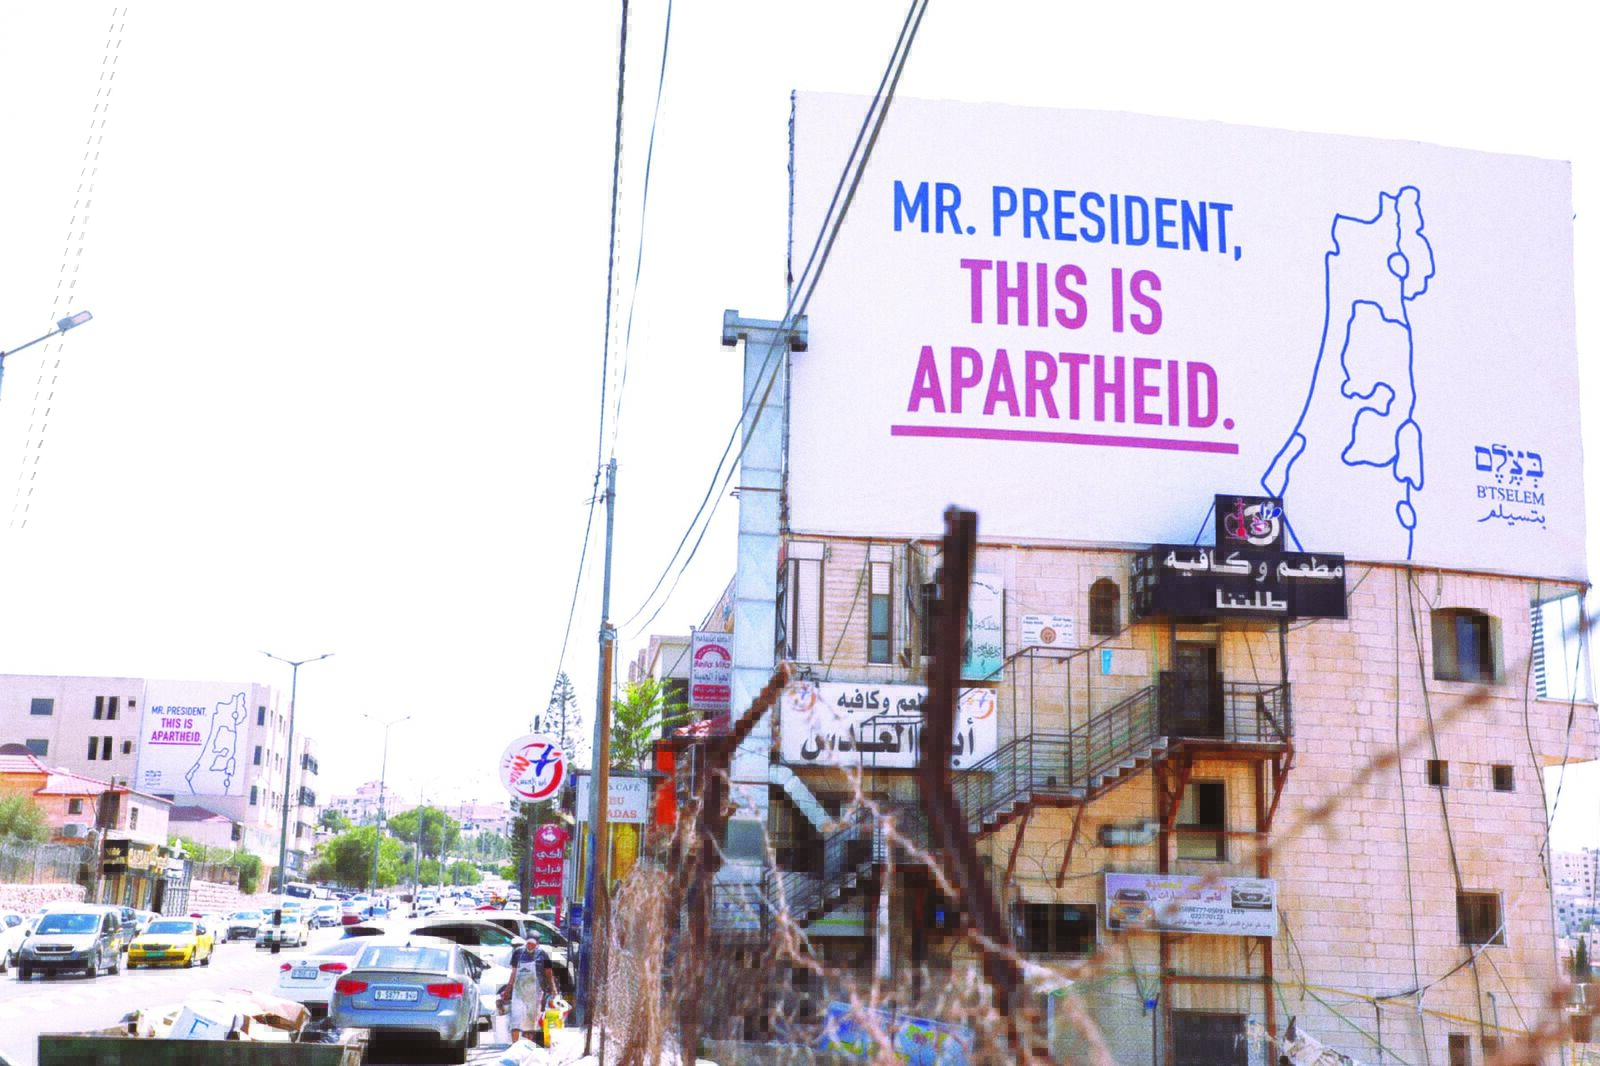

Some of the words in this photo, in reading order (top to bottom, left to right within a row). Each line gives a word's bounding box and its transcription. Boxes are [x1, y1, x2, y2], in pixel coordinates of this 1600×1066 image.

[893, 179, 977, 236] MR.
[992, 185, 1243, 262] PRESIDENT,
[960, 258, 1088, 331] THIS
[1111, 267, 1163, 336] IS
[907, 345, 1236, 430] APARTHEID.
[1276, 556, 1344, 582] مطعم
[896, 692, 927, 716] طعم
[151, 731, 202, 742] APARTHEID.
[161, 718, 181, 729] THIS
[184, 718, 194, 729] IS
